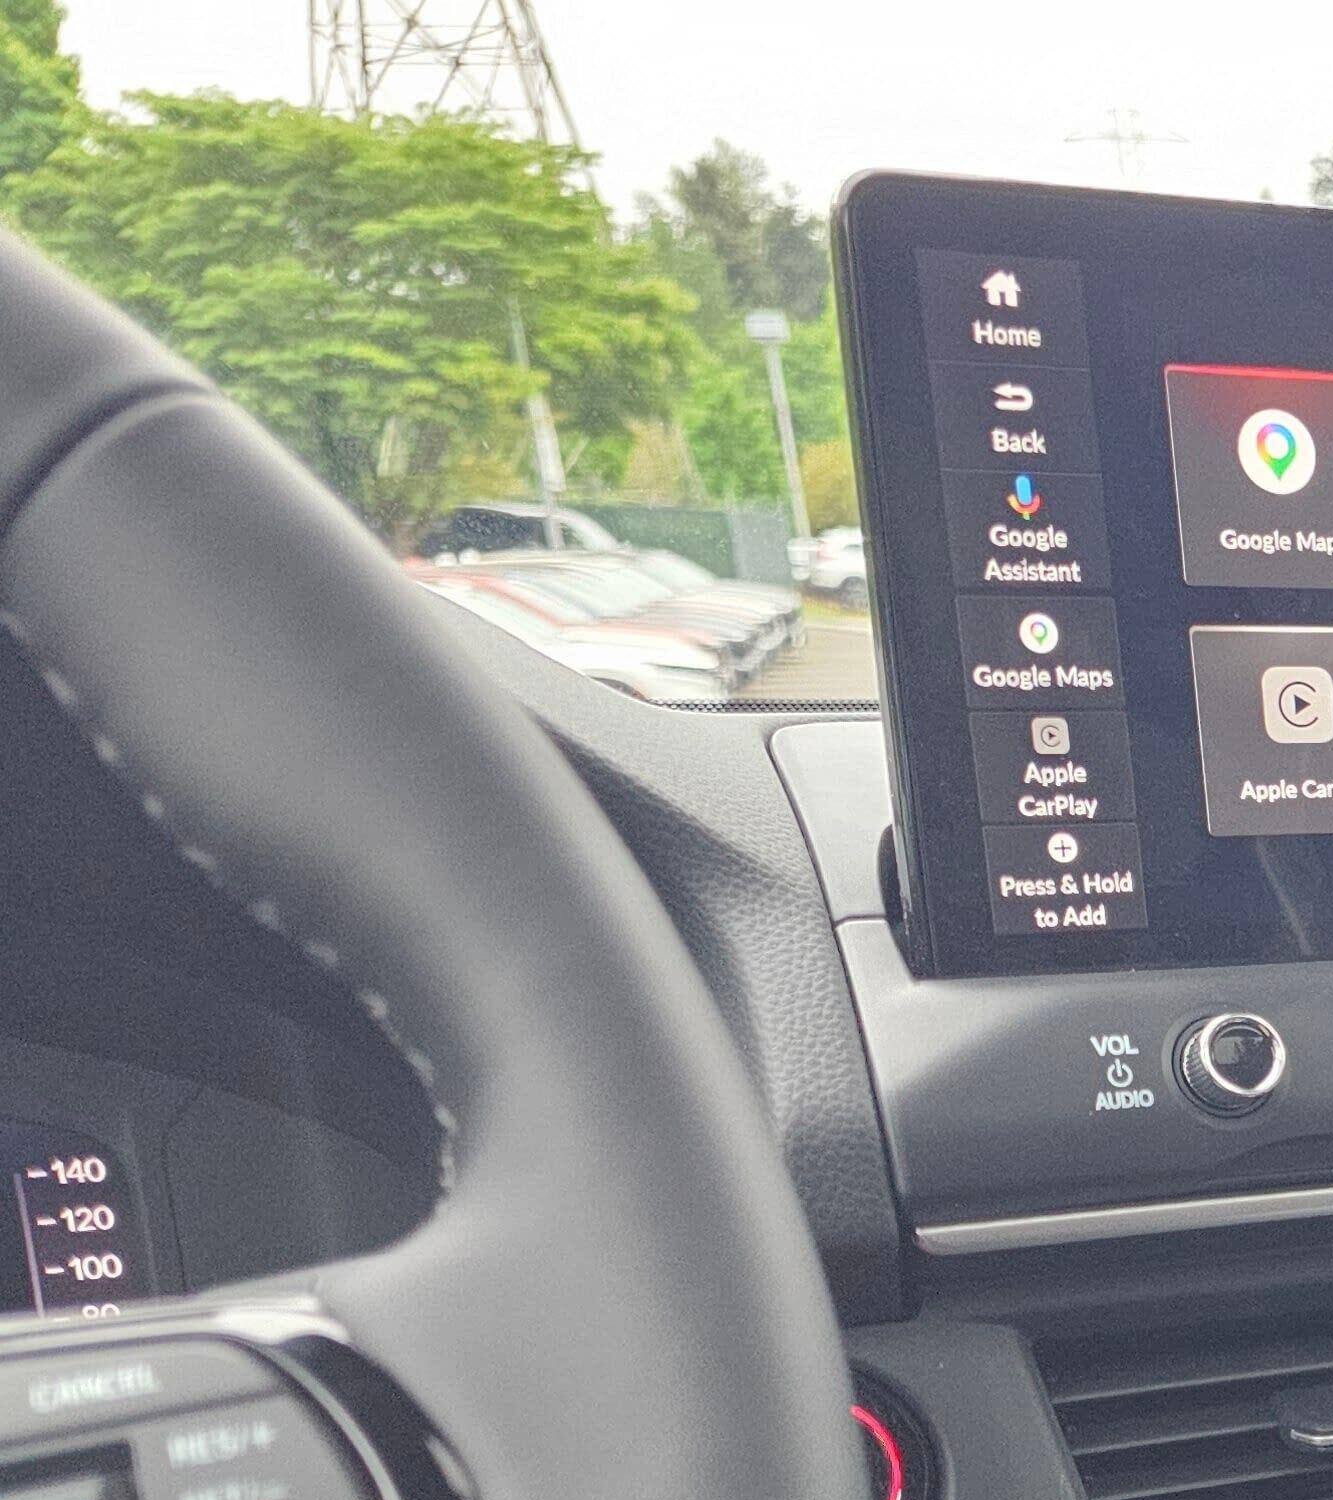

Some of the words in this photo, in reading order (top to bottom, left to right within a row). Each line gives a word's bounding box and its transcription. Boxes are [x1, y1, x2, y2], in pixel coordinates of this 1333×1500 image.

[972, 319, 1041, 348] Home
[991, 429, 1046, 455] Back
[989, 525, 1068, 551] Google
[1220, 529, 1291, 554] Google
[984, 558, 1082, 584] Assistant
[973, 664, 1051, 691] Google
[1055, 665, 1114, 690] Maps
[1024, 762, 1088, 787] Apple
[1239, 780, 1298, 802] Apple
[1018, 795, 1098, 819] CarPlay
[1000, 873, 1056, 898] Press
[1060, 873, 1080, 896] &
[1083, 871, 1134, 896] Hold
[1034, 907, 1059, 929] to
[1062, 904, 1107, 928] Add
[1089, 1034, 1140, 1057] VOL
[1095, 1088, 1155, 1112] AUDIO
[51, 1156, 107, 1186] 140
[60, 1204, 116, 1233] 120
[68, 1252, 123, 1281] 100
